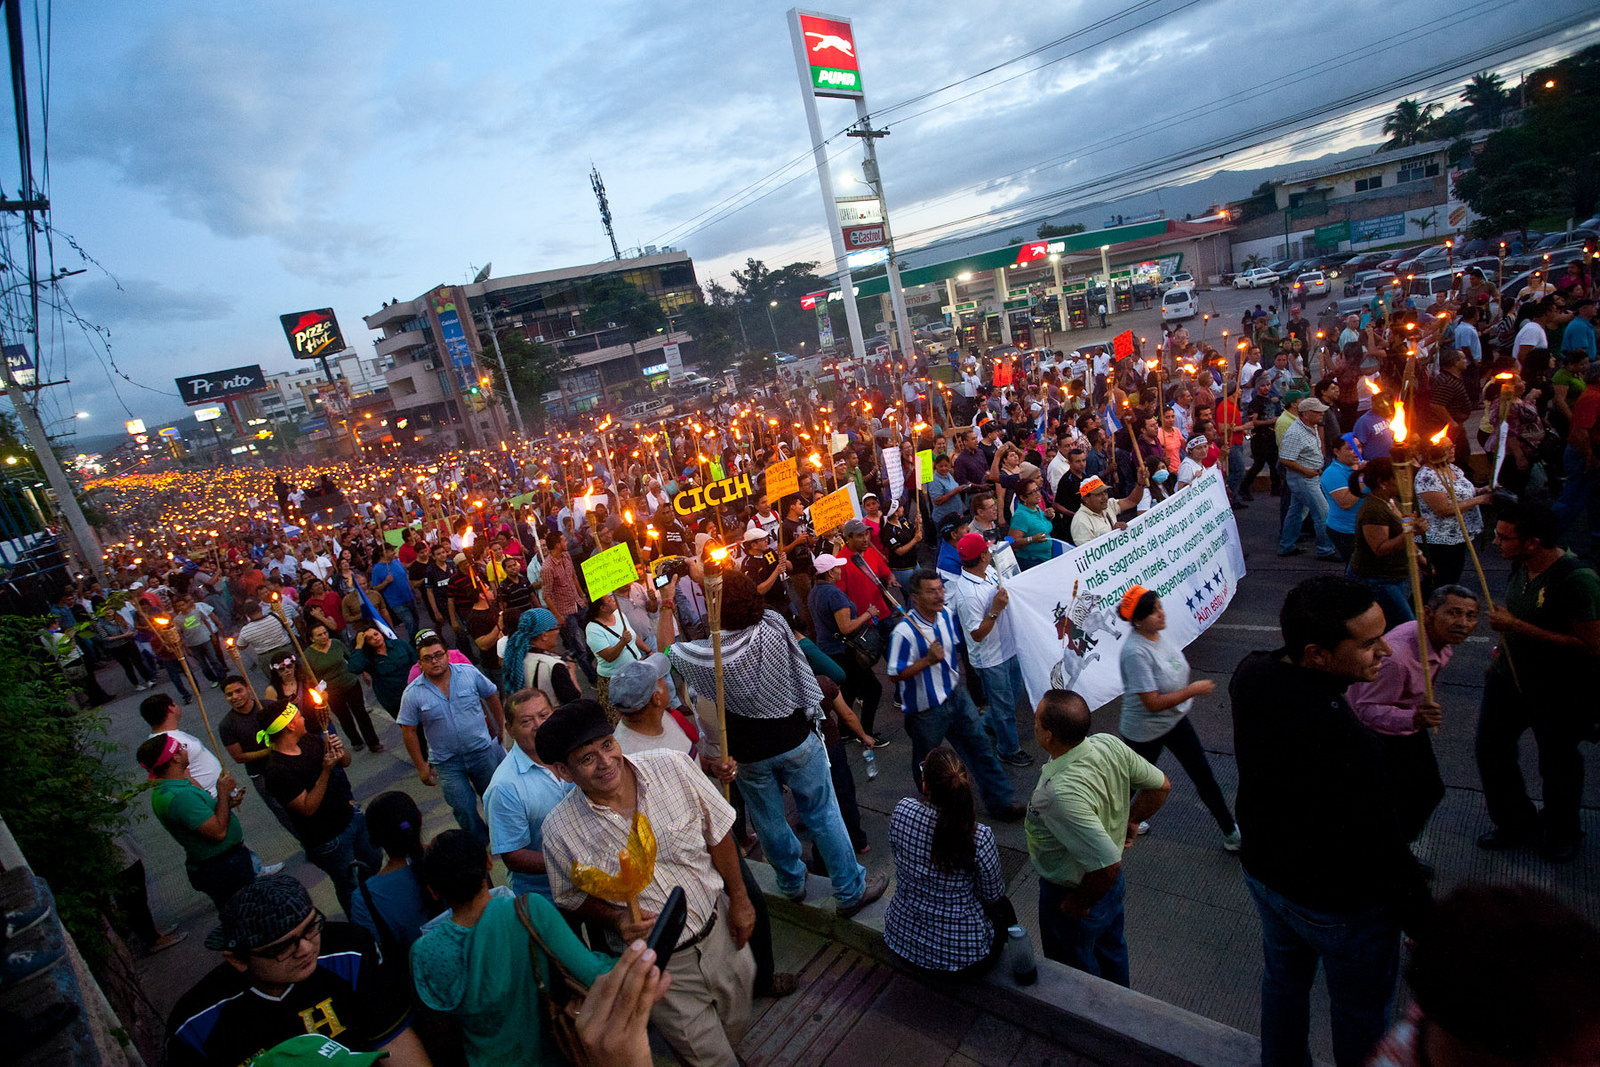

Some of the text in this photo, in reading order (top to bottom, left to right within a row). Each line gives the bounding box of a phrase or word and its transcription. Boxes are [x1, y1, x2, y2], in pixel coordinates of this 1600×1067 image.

[818, 70, 856, 86] PUMA
[859, 230, 881, 243] Castrol
[828, 287, 860, 302] PUA
[295, 320, 332, 352] Pizza
[305, 330, 332, 353] Hut
[187, 374, 255, 395] Pronto
[673, 473, 752, 516] CICIH
[1130, 523, 1144, 541] que
[1165, 495, 1186, 518] abusado
[1197, 473, 1217, 493] derechos
[763, 551, 777, 566] H
[1086, 570, 1109, 590] más
[1109, 545, 1147, 576] sagrados
[1147, 534, 1159, 552] del
[1158, 523, 1180, 549] pueblo
[1179, 516, 1189, 534] por
[1187, 512, 1196, 525] un
[1200, 552, 1209, 566] de
[1099, 574, 1142, 611] mezquino
[1168, 547, 1184, 563] Con
[1182, 531, 1204, 553] vosotros
[298, 997, 347, 1039] H
